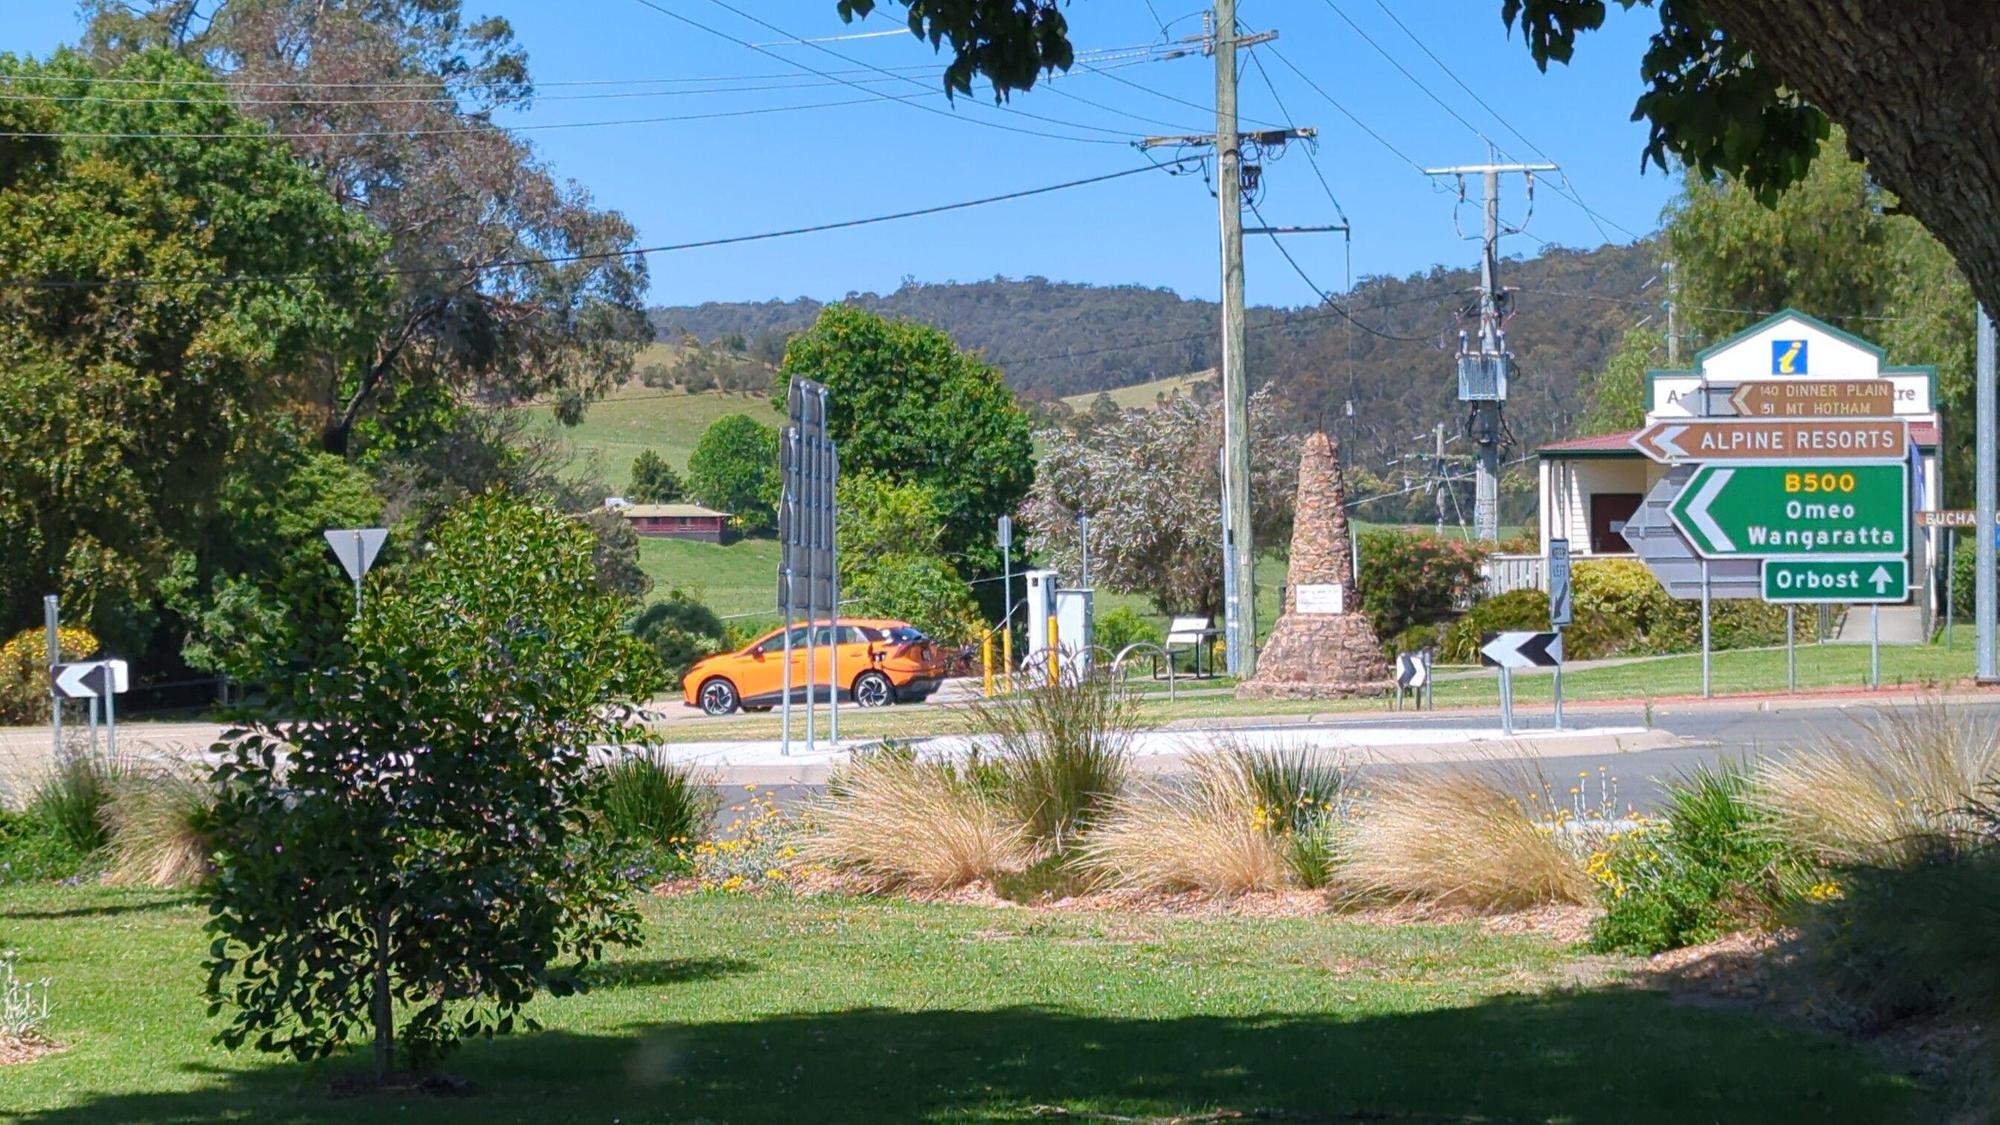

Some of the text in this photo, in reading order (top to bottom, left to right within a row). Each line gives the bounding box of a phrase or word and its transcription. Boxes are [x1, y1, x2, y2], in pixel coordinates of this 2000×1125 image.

[1761, 384, 1888, 397] 140 DINNER PLAIN
[1786, 403, 1804, 415] MT
[1814, 403, 1870, 414] HOTHAM
[1701, 431, 1894, 449] ALPINE RESORTS
[1785, 473, 1854, 492] B500
[1786, 501, 1855, 519] Omeo
[1926, 512, 1976, 525] BUCHA
[1748, 526, 1895, 550] Wangaratta
[1776, 570, 1859, 588] Orbost
